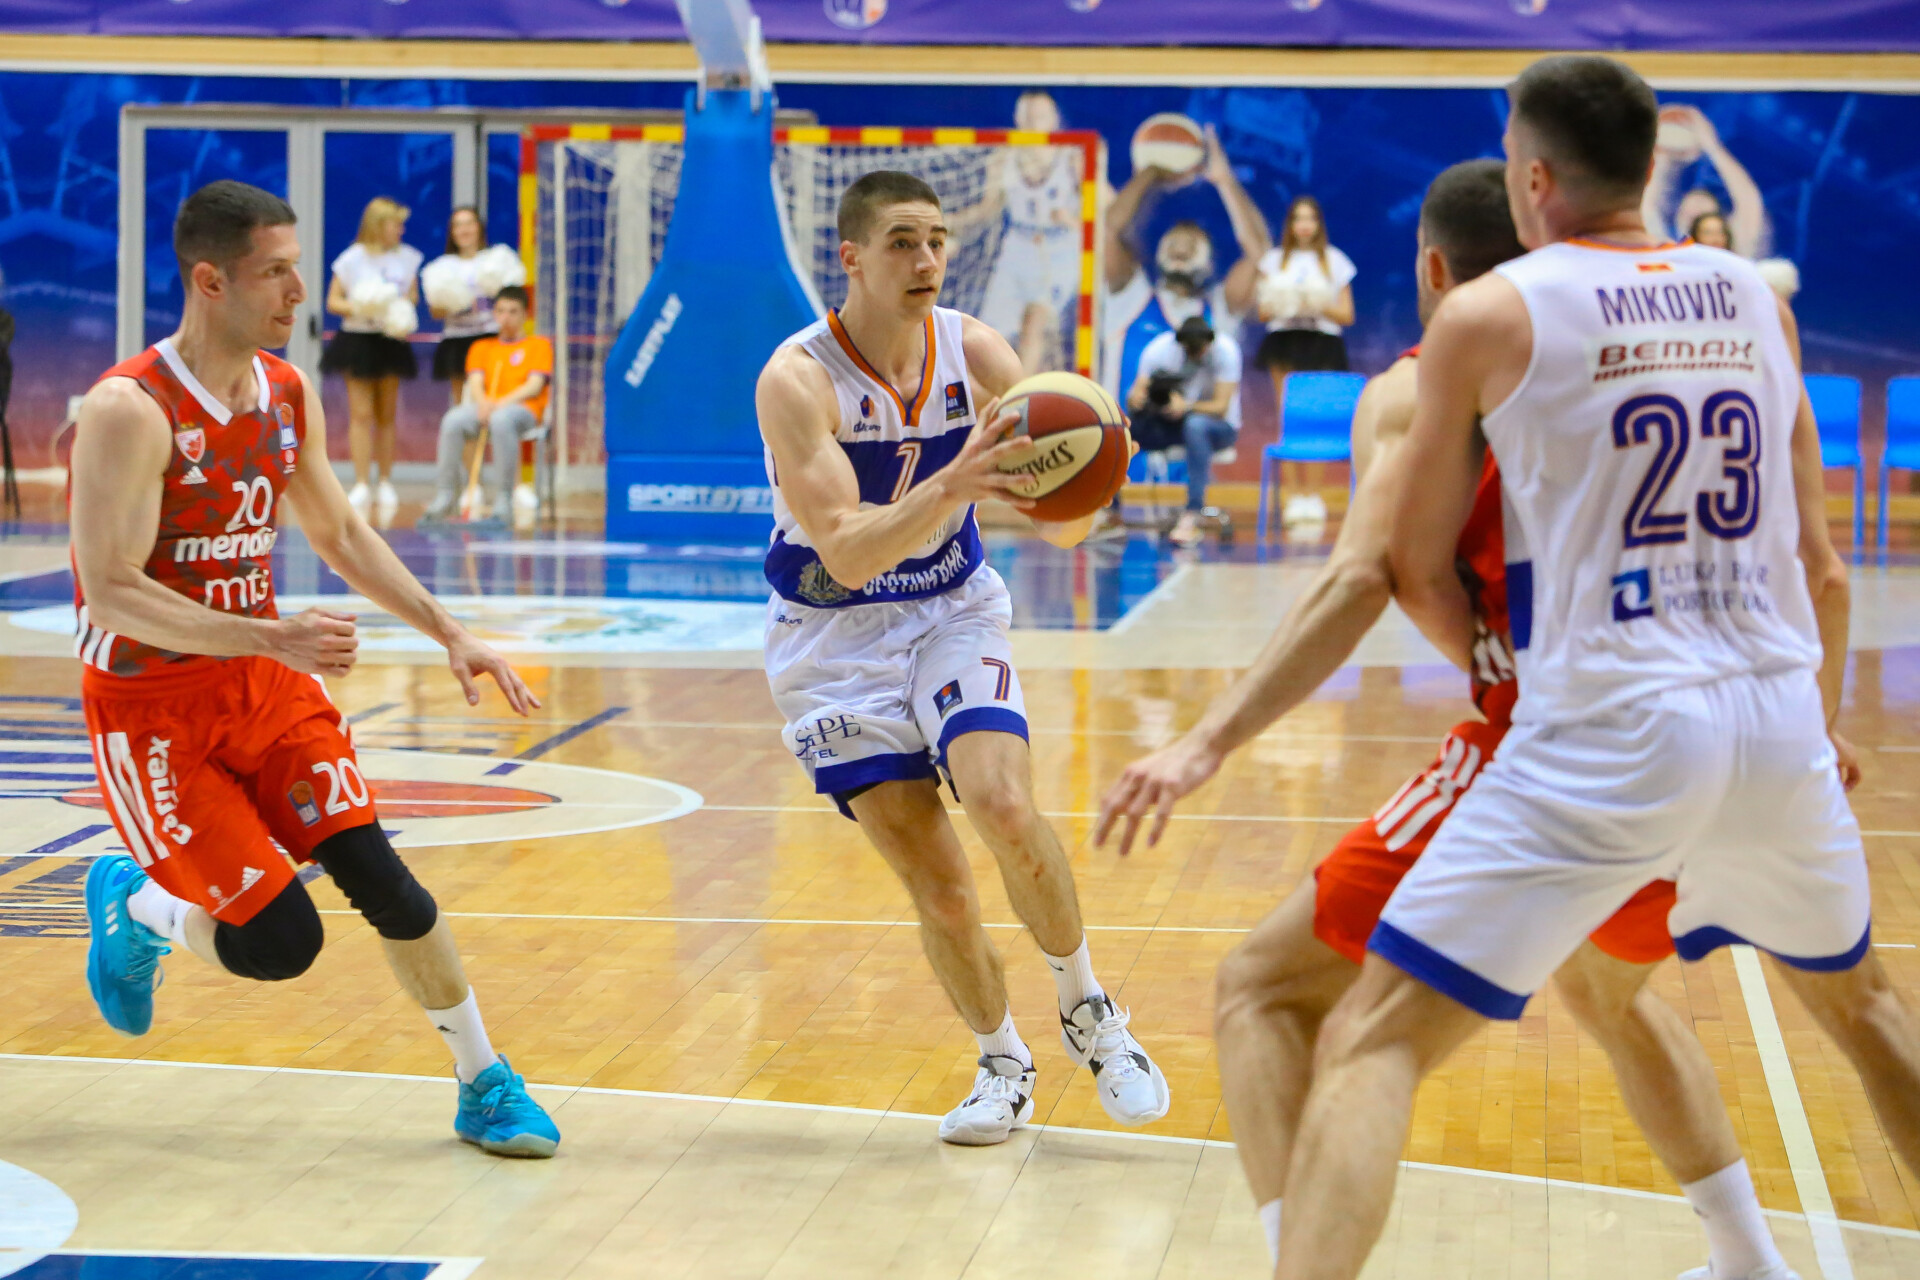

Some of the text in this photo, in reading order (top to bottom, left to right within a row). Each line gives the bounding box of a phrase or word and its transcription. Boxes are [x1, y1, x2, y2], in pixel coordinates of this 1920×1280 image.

[1600, 341, 1753, 367] BEMAX
[890, 442, 922, 501] 7
[1611, 390, 1761, 549] 23
[226, 475, 274, 533] 20
[980, 656, 1012, 703] 7
[310, 757, 369, 817] 20
